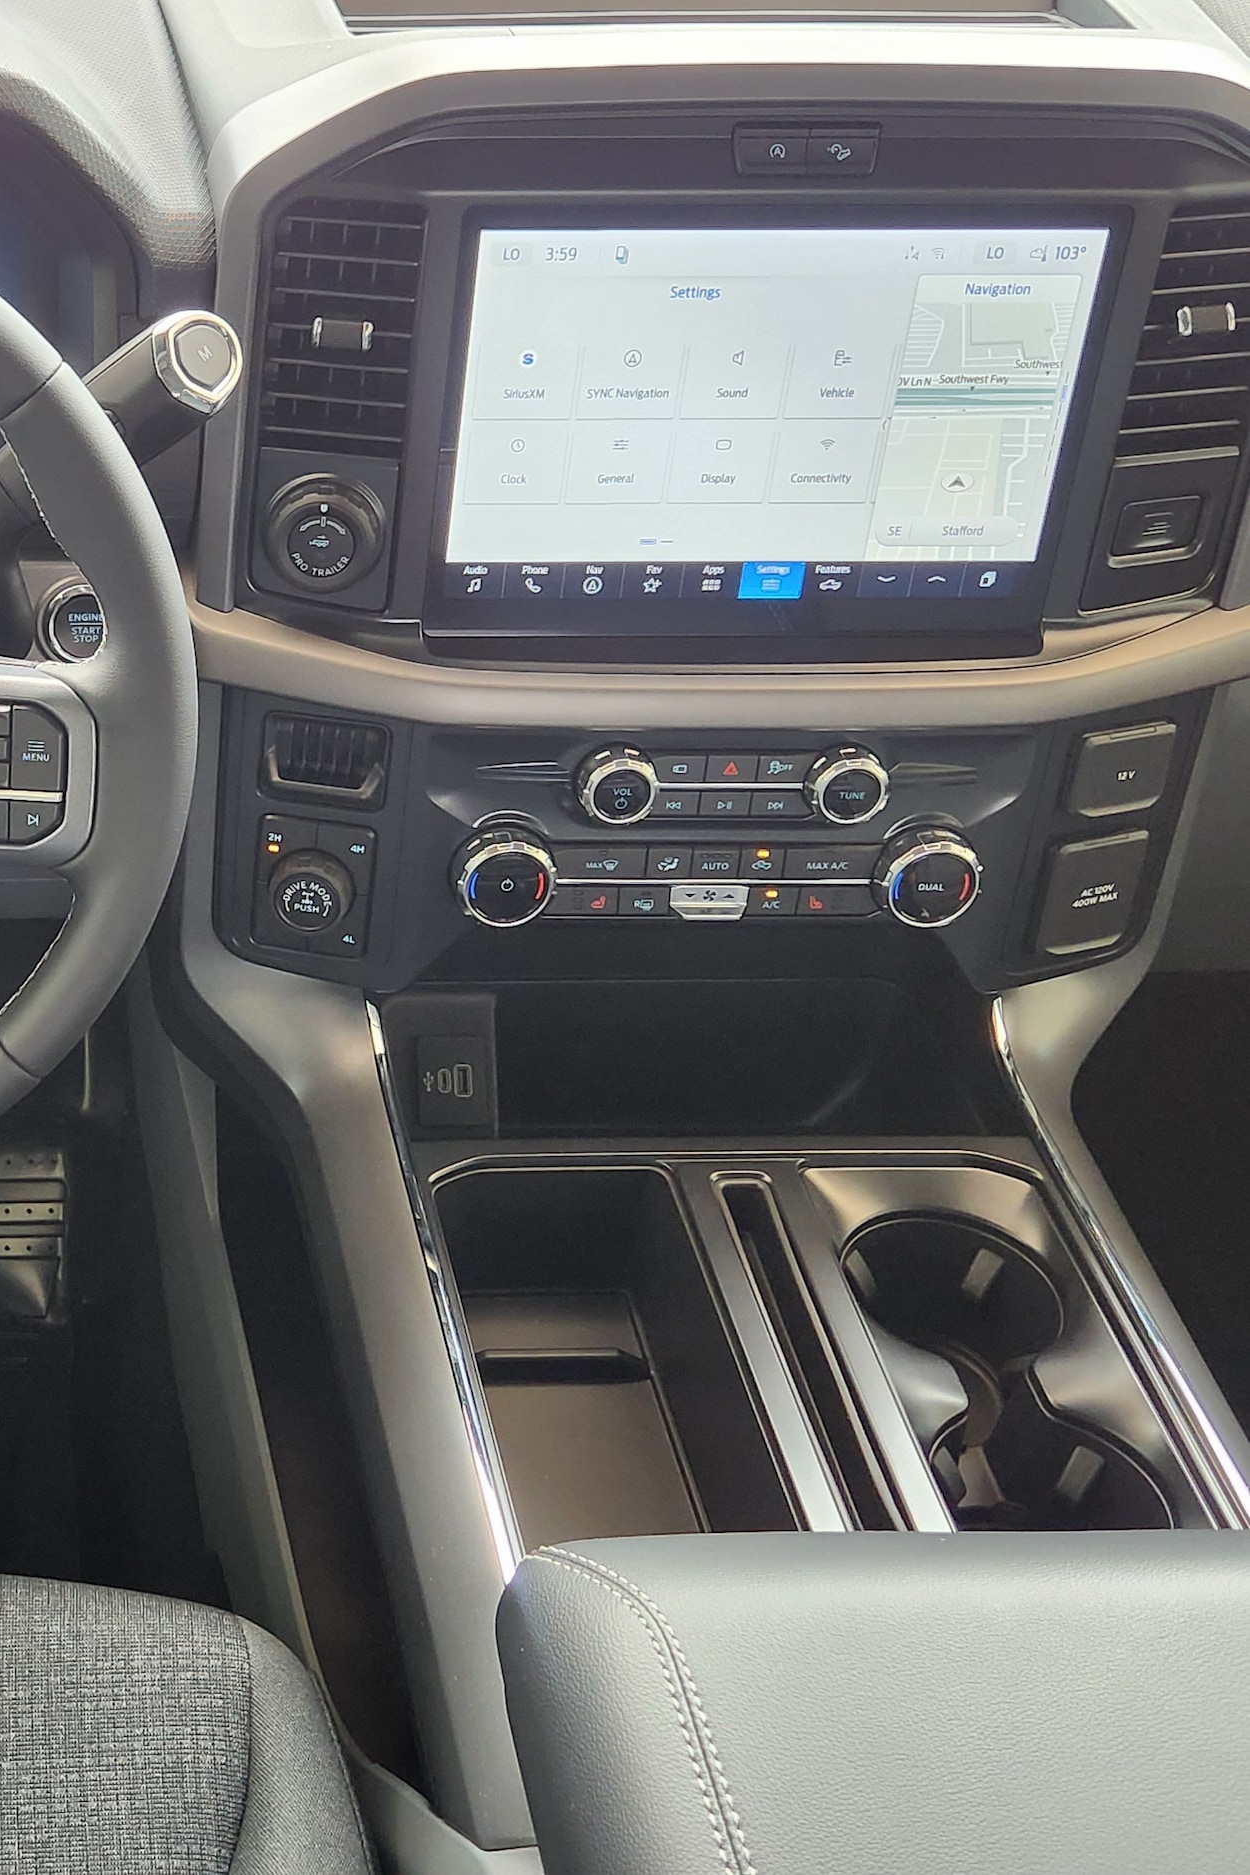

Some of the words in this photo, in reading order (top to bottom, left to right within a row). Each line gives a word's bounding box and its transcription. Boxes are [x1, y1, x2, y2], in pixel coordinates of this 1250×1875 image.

[503, 247, 520, 261] LO
[544, 247, 578, 261] 3:59
[986, 247, 1004, 260] LO
[1054, 246, 1087, 260] 103°
[669, 286, 721, 301] Settings
[964, 283, 1031, 297] Navigation
[197, 345, 213, 362] M
[924, 377, 932, 386] N
[938, 374, 988, 385] Southwest
[990, 374, 1010, 386] Fwy
[503, 388, 545, 399] SiriusXM
[586, 388, 614, 399] SYNC
[616, 388, 669, 402] Navigation
[716, 387, 749, 398] Sound
[820, 387, 855, 398] Vehicle
[501, 474, 527, 485] Clock
[598, 474, 635, 484] General
[700, 473, 737, 485] Display
[790, 473, 853, 485] Connectivity
[887, 526, 903, 537] SE
[941, 525, 985, 536] Stafford
[291, 552, 309, 571] PRO
[311, 556, 351, 577] TRAILER
[462, 564, 489, 576] Audio
[520, 564, 550, 576] Phone
[585, 564, 605, 576] Nav
[645, 564, 664, 576] Fav
[702, 564, 726, 577] Apps
[814, 564, 852, 576] Features
[755, 564, 792, 578] Settings
[71, 626, 102, 636] START
[73, 635, 99, 644] STOP
[22, 752, 51, 763] MENU
[613, 787, 633, 797] VOL
[839, 791, 866, 801] TUNE
[268, 832, 283, 843] 2H
[350, 844, 366, 855] 4H
[701, 862, 730, 872] AUTO
[806, 862, 829, 871] MAX
[830, 861, 849, 871] A/C
[918, 881, 945, 893] DUAL
[1080, 887, 1094, 898] AC
[282, 880, 307, 902] DRIVE
[309, 881, 333, 908] MODE
[1098, 891, 1120, 904] MAX
[293, 903, 321, 914] PUSH
[761, 899, 781, 911] A/C
[342, 934, 356, 945] 4L
